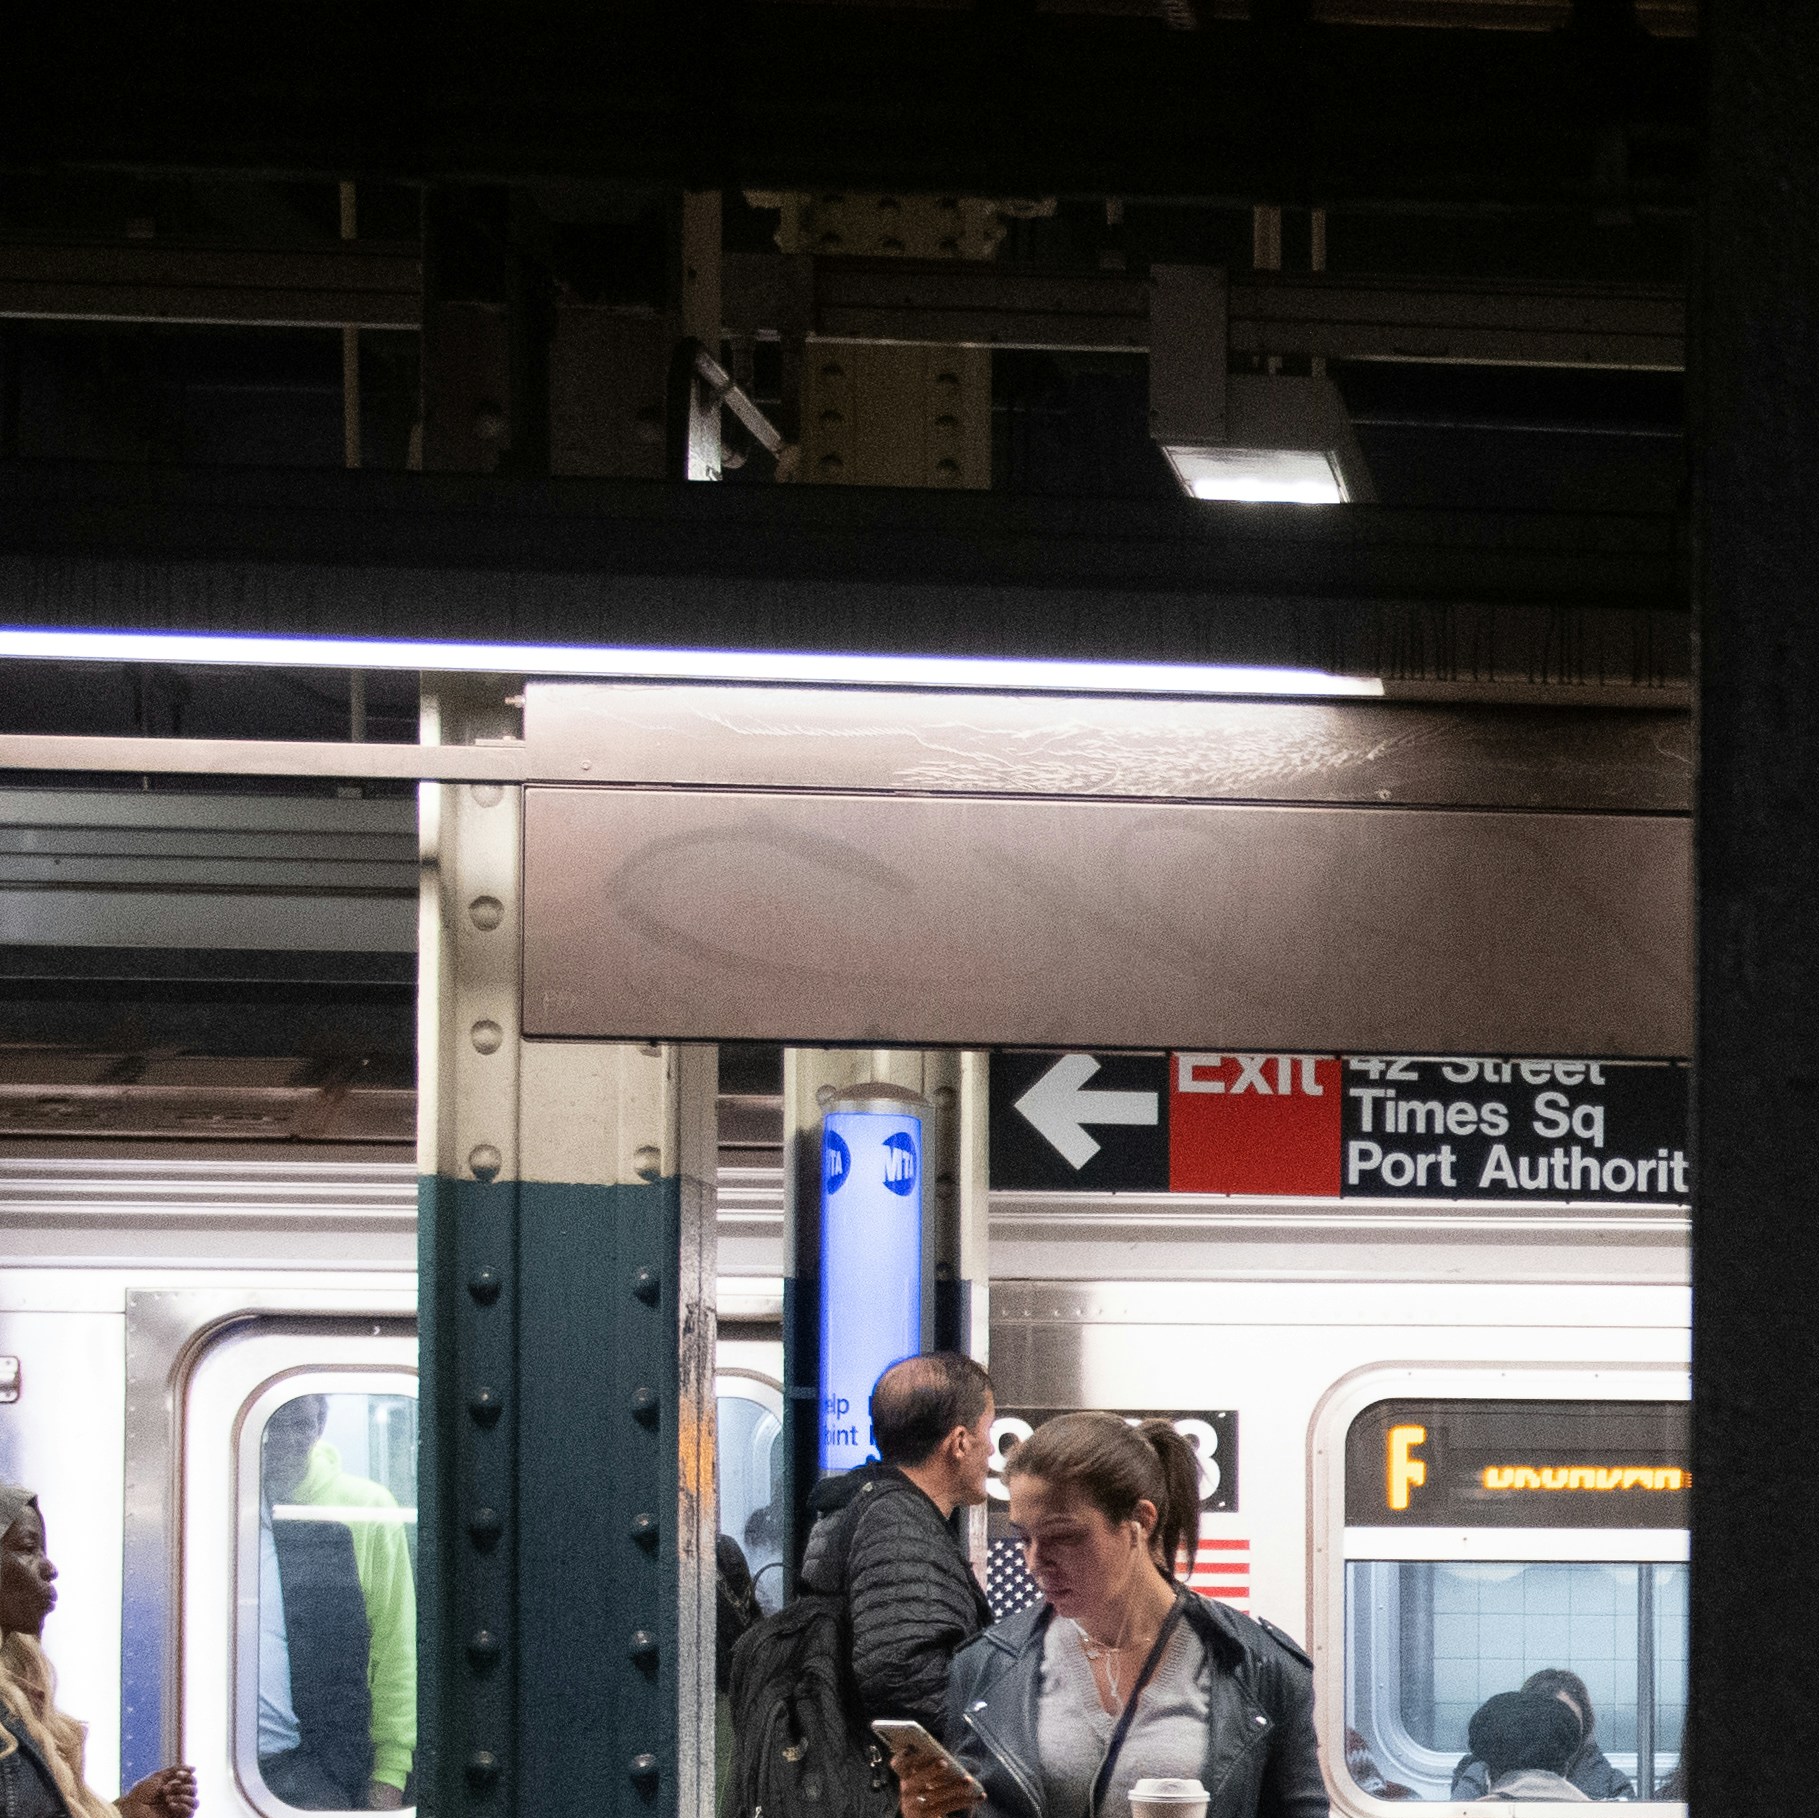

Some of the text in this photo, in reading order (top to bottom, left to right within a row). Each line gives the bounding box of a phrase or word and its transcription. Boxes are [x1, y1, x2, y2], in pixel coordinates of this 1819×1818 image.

[1178, 1055, 1324, 1096] Exit
[1349, 1088, 1604, 1148] Times Sq
[1348, 1141, 1689, 1193] Port Authorit
[1386, 1423, 1427, 1511] F
